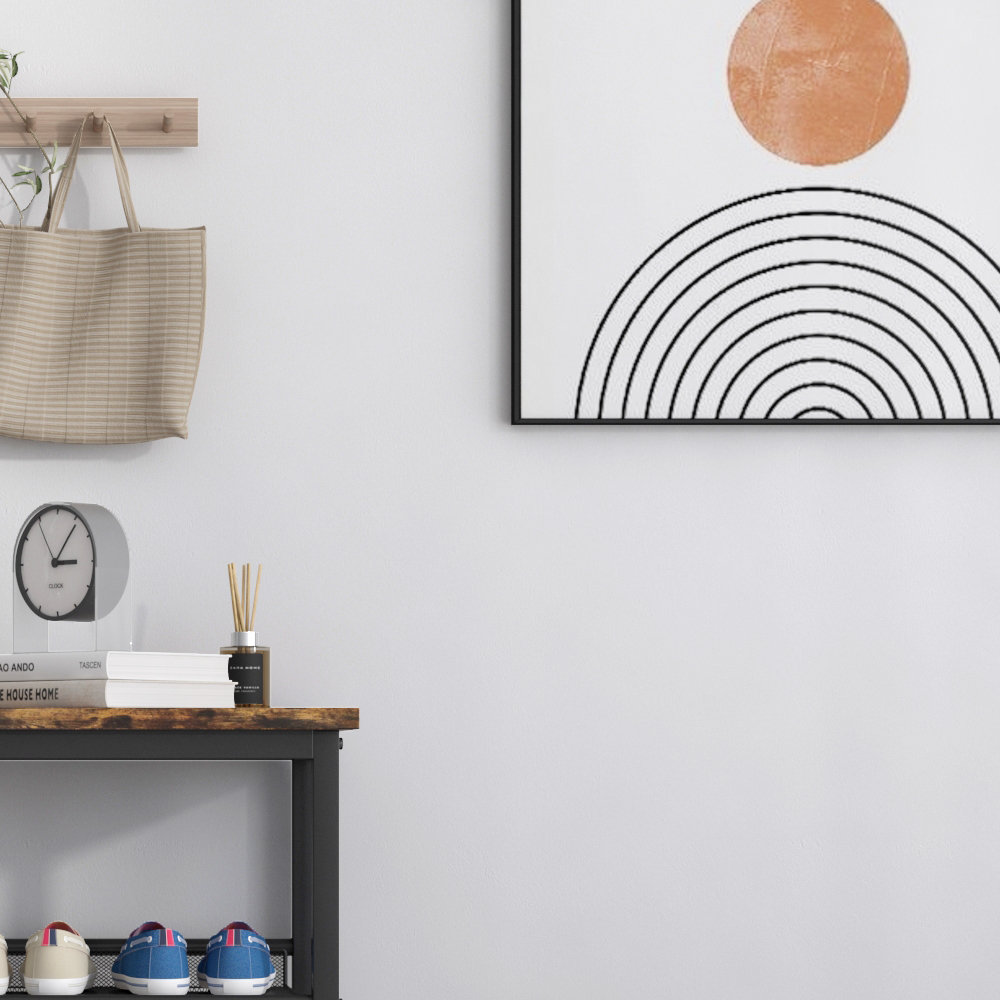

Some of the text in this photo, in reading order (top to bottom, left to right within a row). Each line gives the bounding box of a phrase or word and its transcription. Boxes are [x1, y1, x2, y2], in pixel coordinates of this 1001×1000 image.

[11, 662, 35, 672] ANDO
[79, 661, 102, 669] TASCEN
[6, 688, 33, 701] HOUSE
[35, 687, 59, 700] HOME
